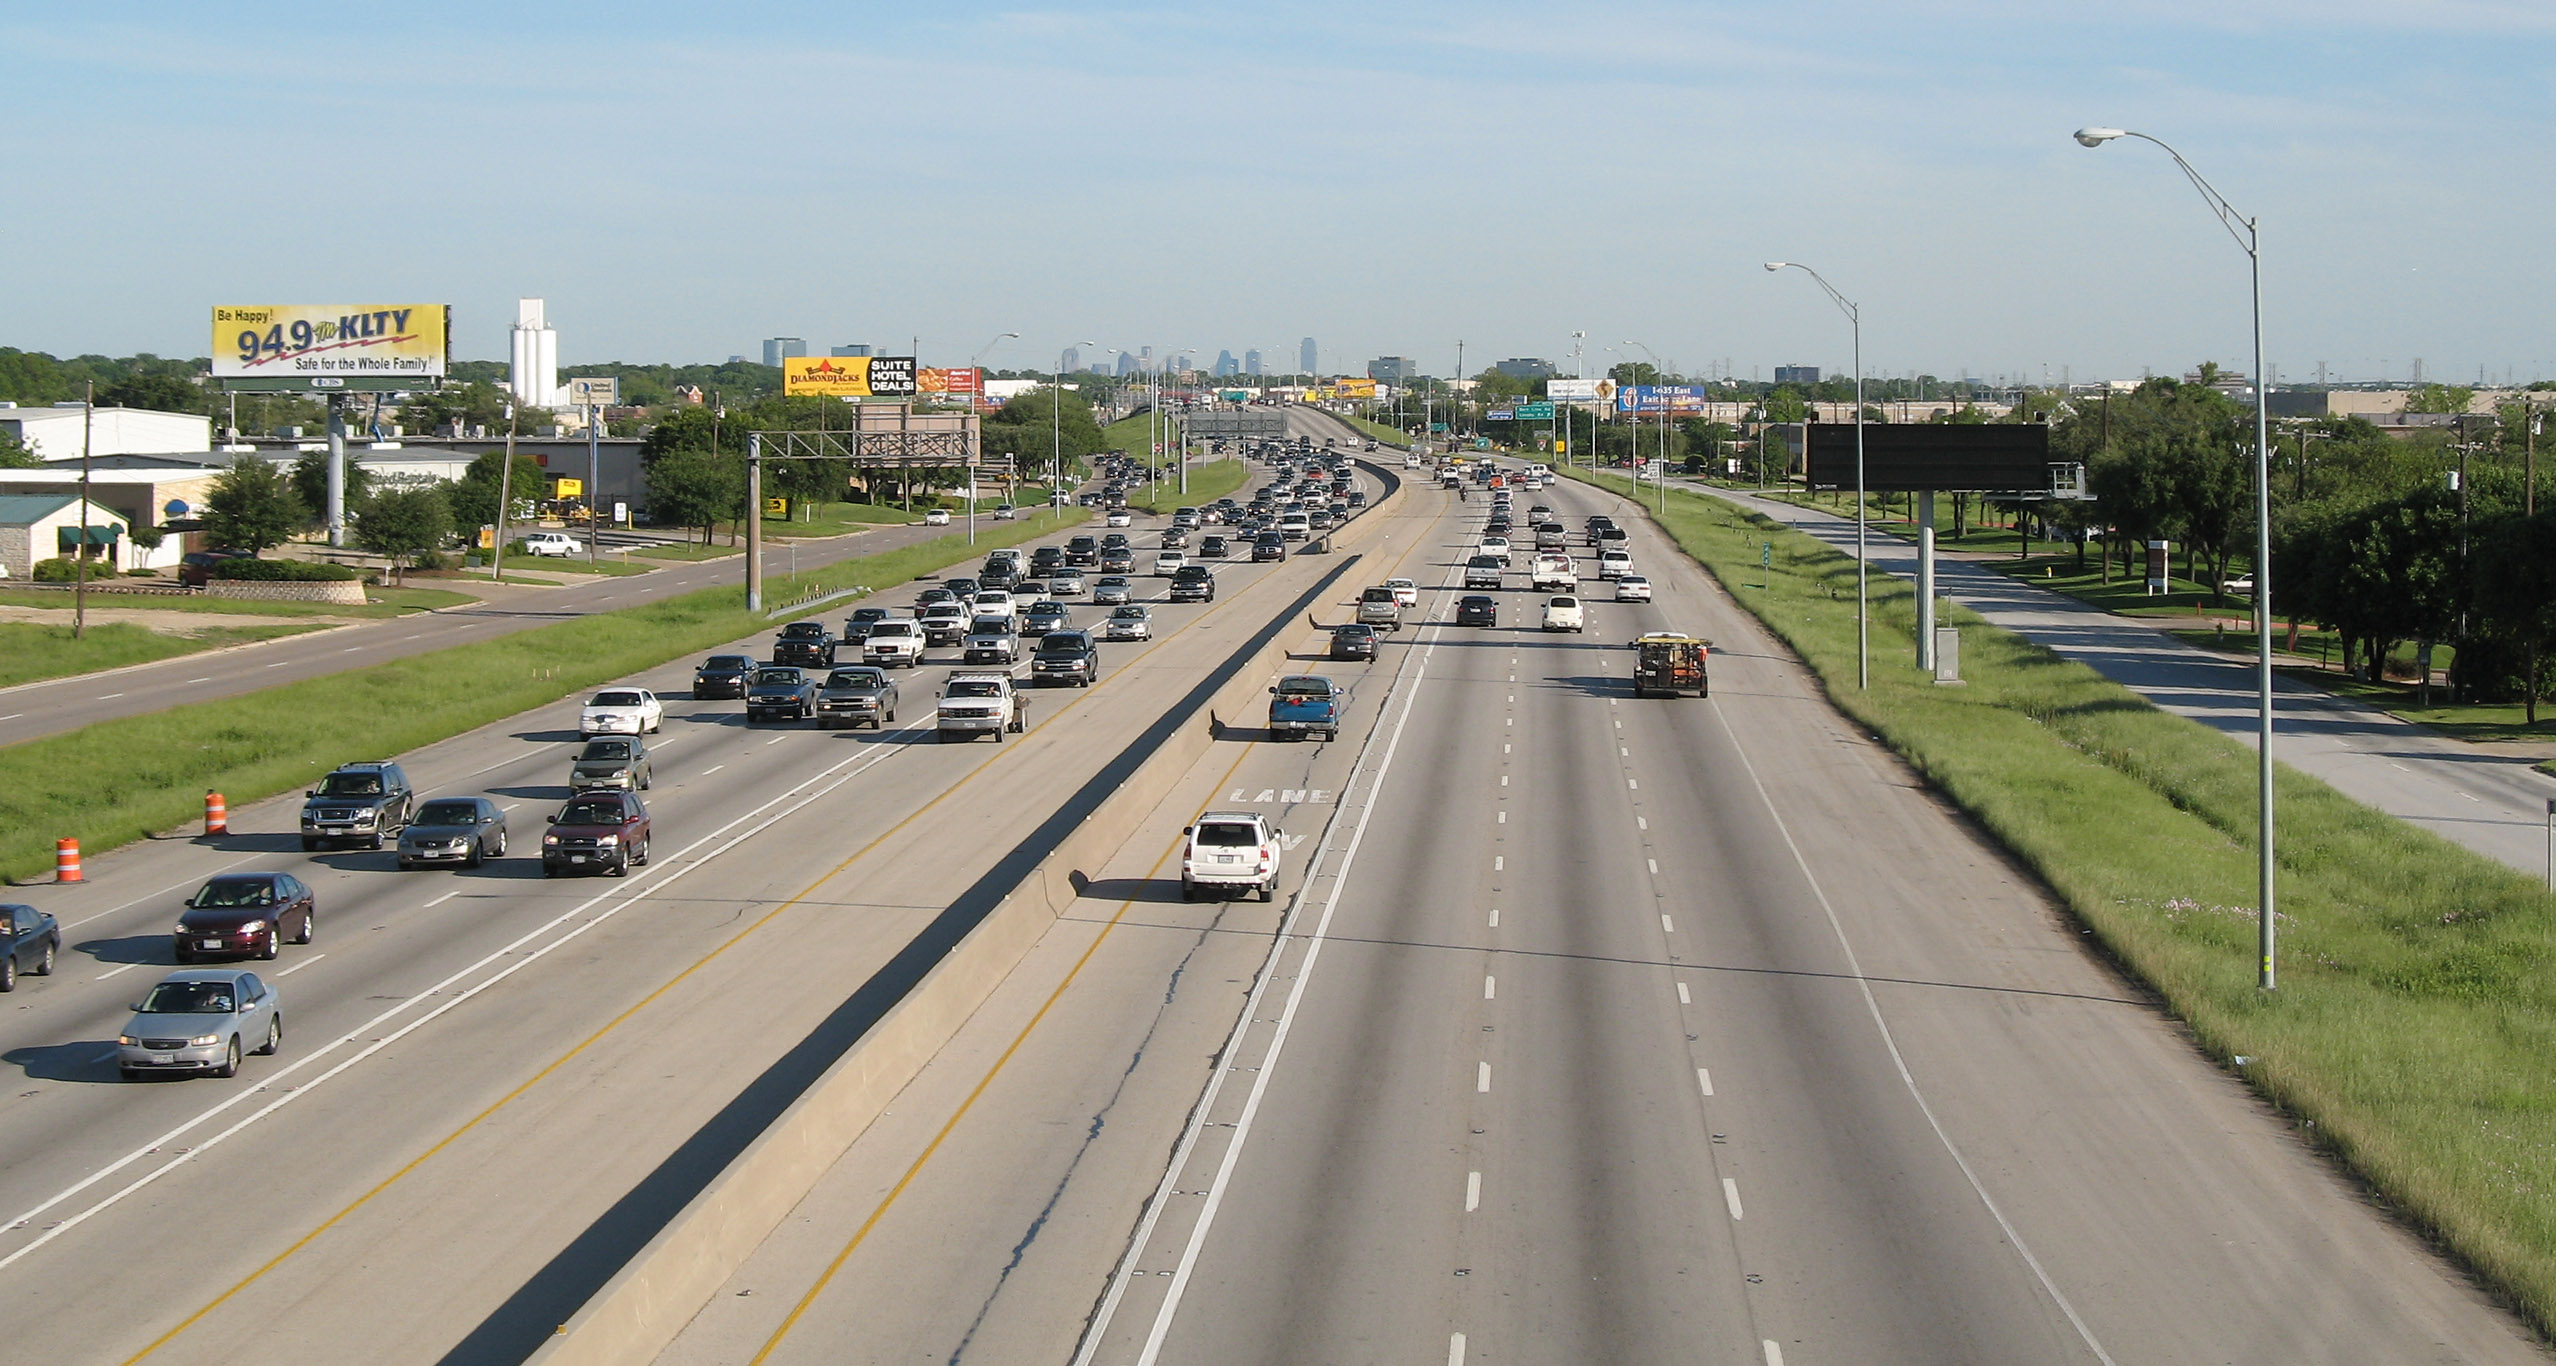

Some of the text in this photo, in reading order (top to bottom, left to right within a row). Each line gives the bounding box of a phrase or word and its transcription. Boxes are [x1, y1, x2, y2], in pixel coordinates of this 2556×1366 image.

[217, 308, 273, 324] Be Happy!
[238, 319, 313, 361] 94.9
[339, 309, 411, 340] KLTY
[296, 355, 432, 372] Safe for the Whole Family!
[871, 360, 911, 370] SUITE
[871, 371, 911, 380] HOTEL
[871, 381, 914, 391] DEALS!
[1229, 788, 1331, 803] LANE
